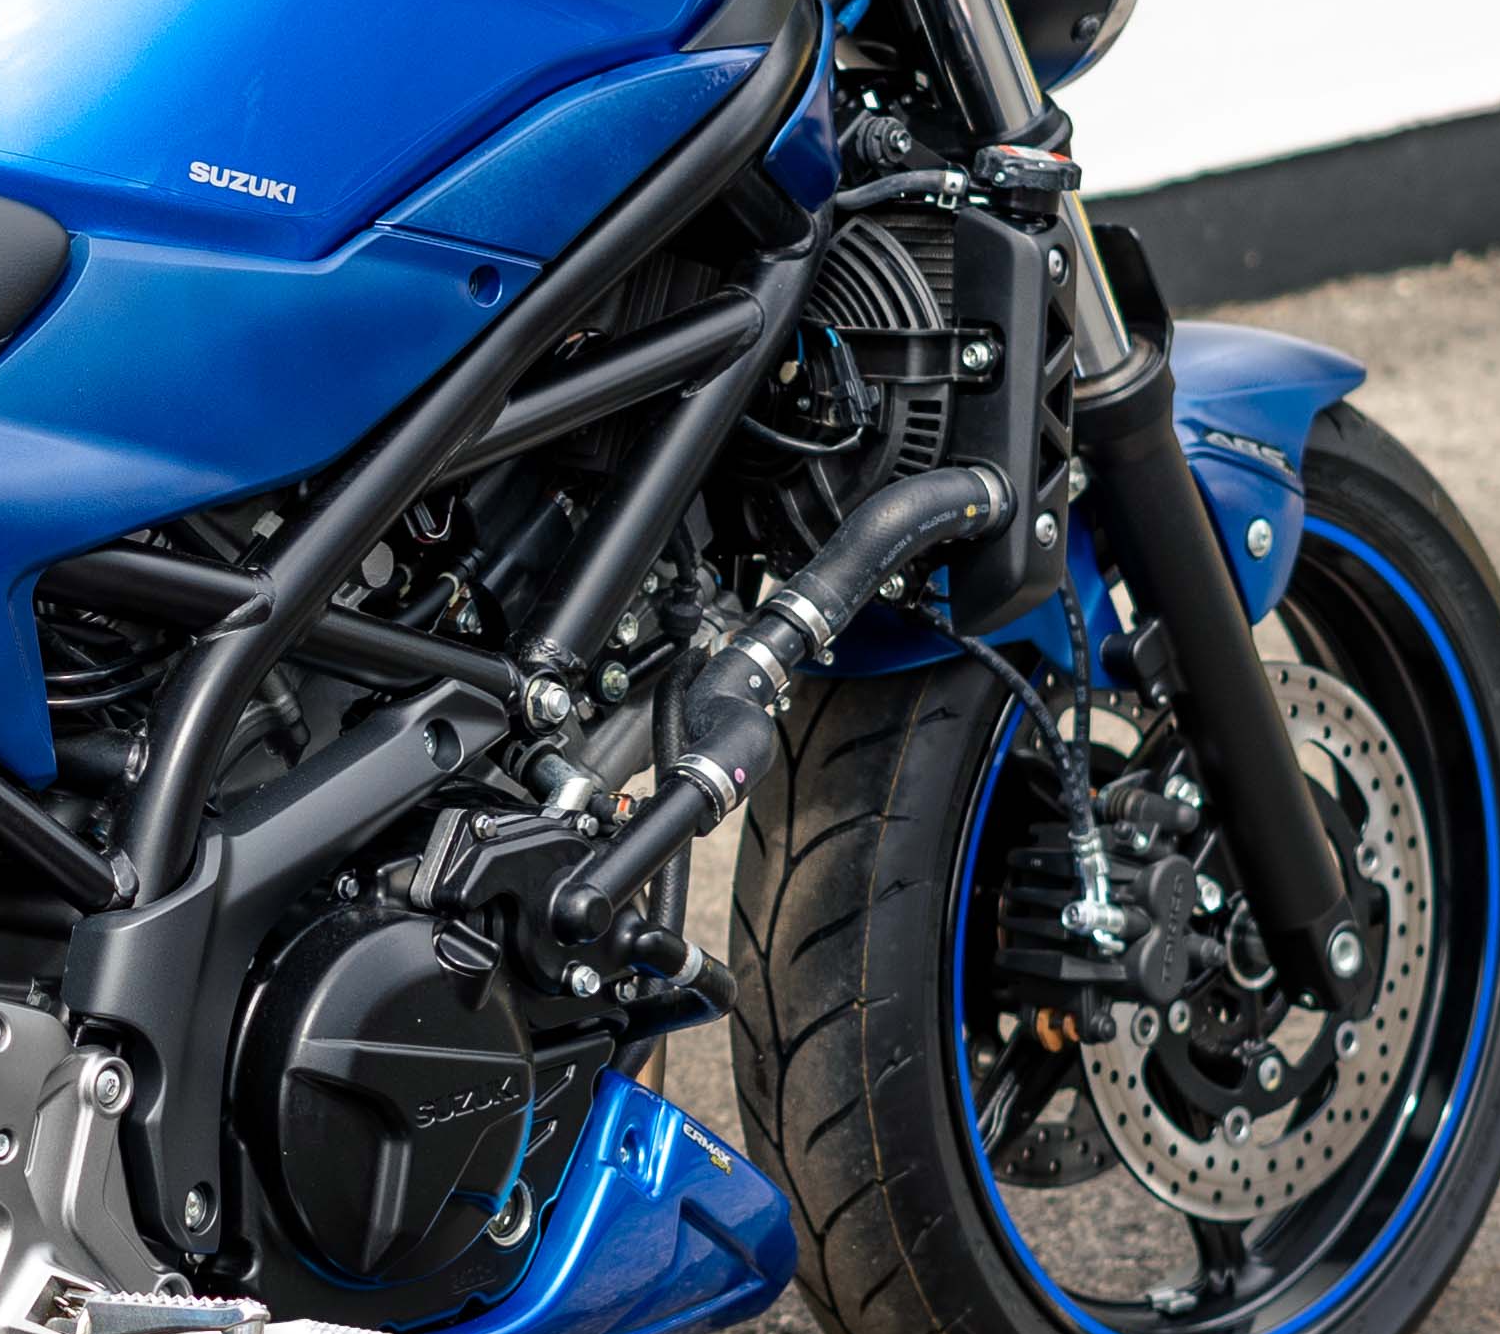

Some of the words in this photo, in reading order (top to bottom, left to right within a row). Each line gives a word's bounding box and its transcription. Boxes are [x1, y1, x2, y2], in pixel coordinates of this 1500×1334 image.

[189, 161, 296, 204] SUZUKI
[1205, 431, 1286, 471] ABS
[416, 1076, 521, 1129] SUZUKI
